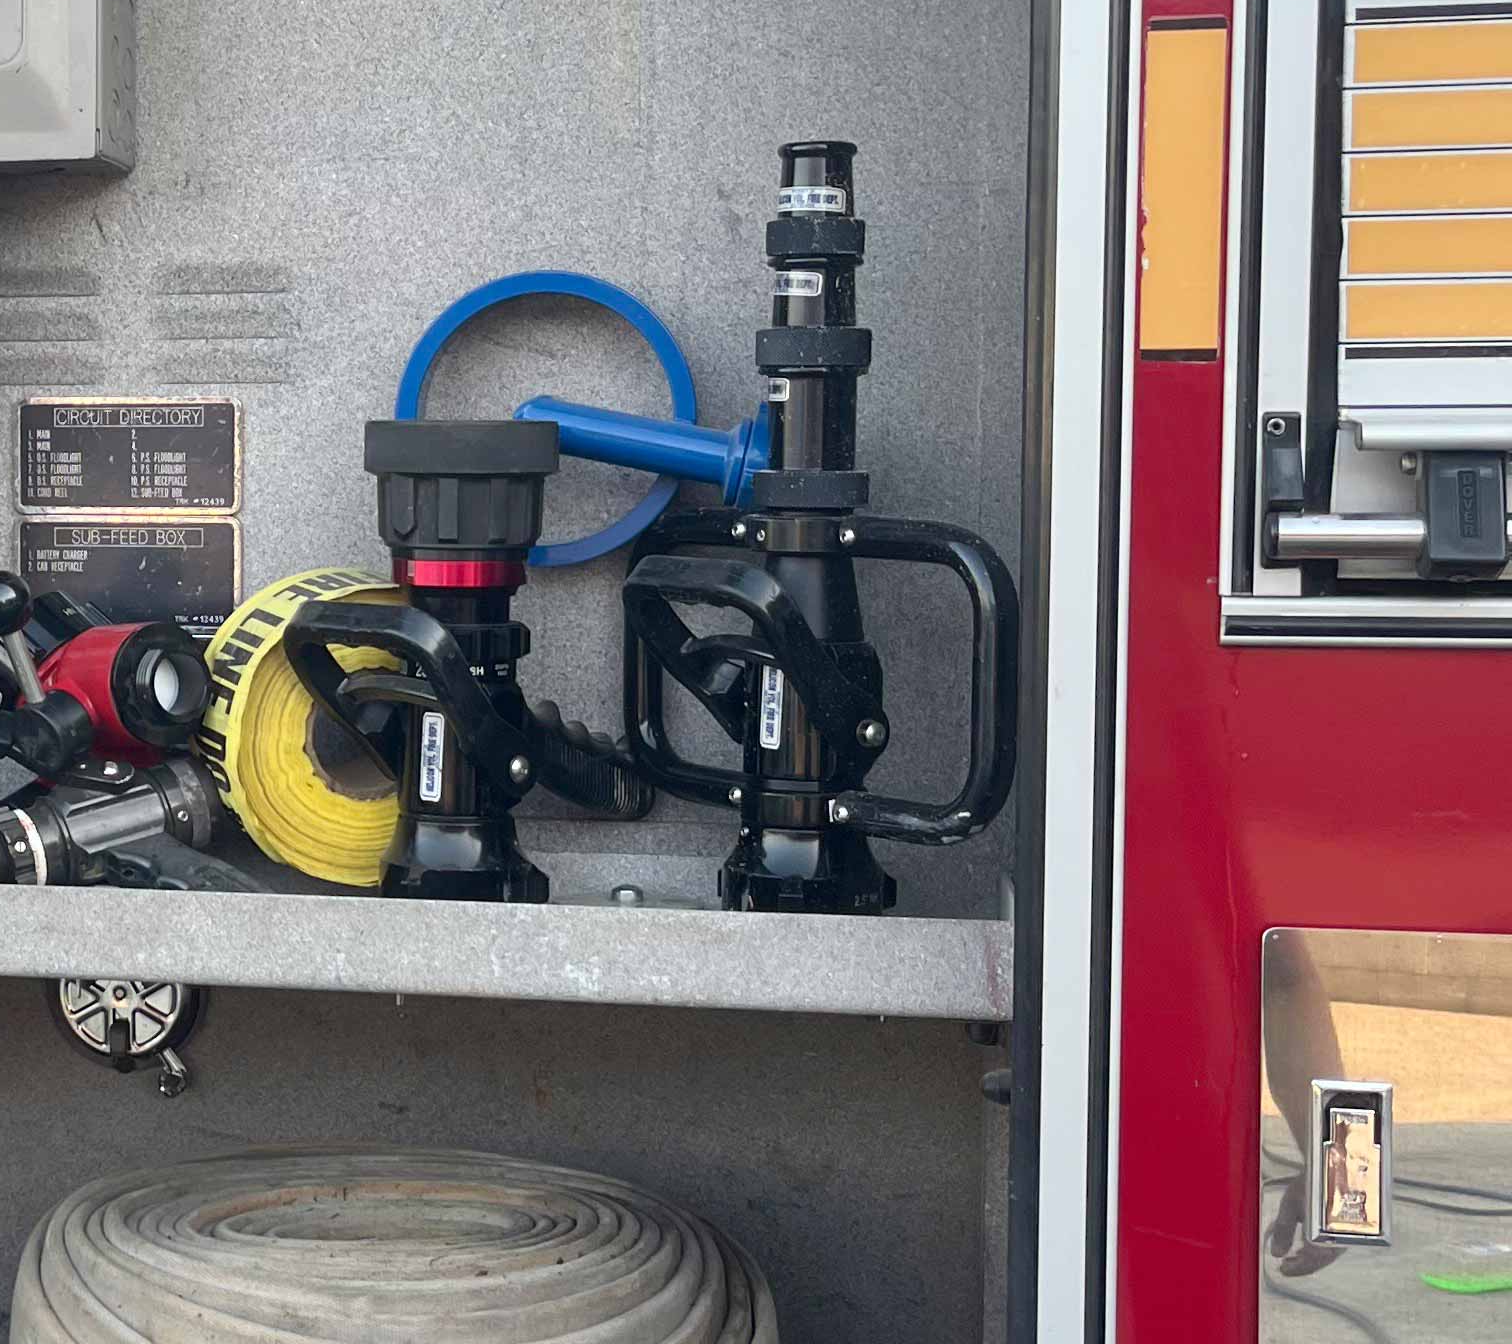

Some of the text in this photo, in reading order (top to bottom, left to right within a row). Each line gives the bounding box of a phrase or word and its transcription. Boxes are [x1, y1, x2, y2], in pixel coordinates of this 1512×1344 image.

[808, 195, 839, 204] FIRE DEPT.
[57, 409, 201, 425] CIRCUIT DIRECTORY
[37, 429, 50, 439] MAIN
[132, 429, 137, 439] 2.
[37, 441, 50, 451] MAIN
[132, 441, 137, 451] 4.
[50, 452, 81, 463] FLOODLIGHT
[141, 452, 151, 463] P.S.
[154, 452, 186, 463] FLOODLIGHT
[50, 464, 81, 474] FLOODLIGHT
[141, 464, 151, 474] P.S.
[154, 464, 186, 474] FLOODLIGHT
[50, 476, 84, 486] RECEPTACLE
[131, 476, 188, 486] 10. P.S. RECEPTACLE
[141, 488, 183, 498] SUB-FEED BOX
[1462, 472, 1474, 536] DOVER
[72, 530, 186, 544] SUB-FEED BOX
[36, 549, 88, 560] BATTERY CHARGER
[36, 562, 83, 572] CAB RECEPTACLE
[208, 608, 285, 715] LINE
[765, 707, 776, 739] FIRE DEPT.
[429, 721, 439, 738] DEPT.
